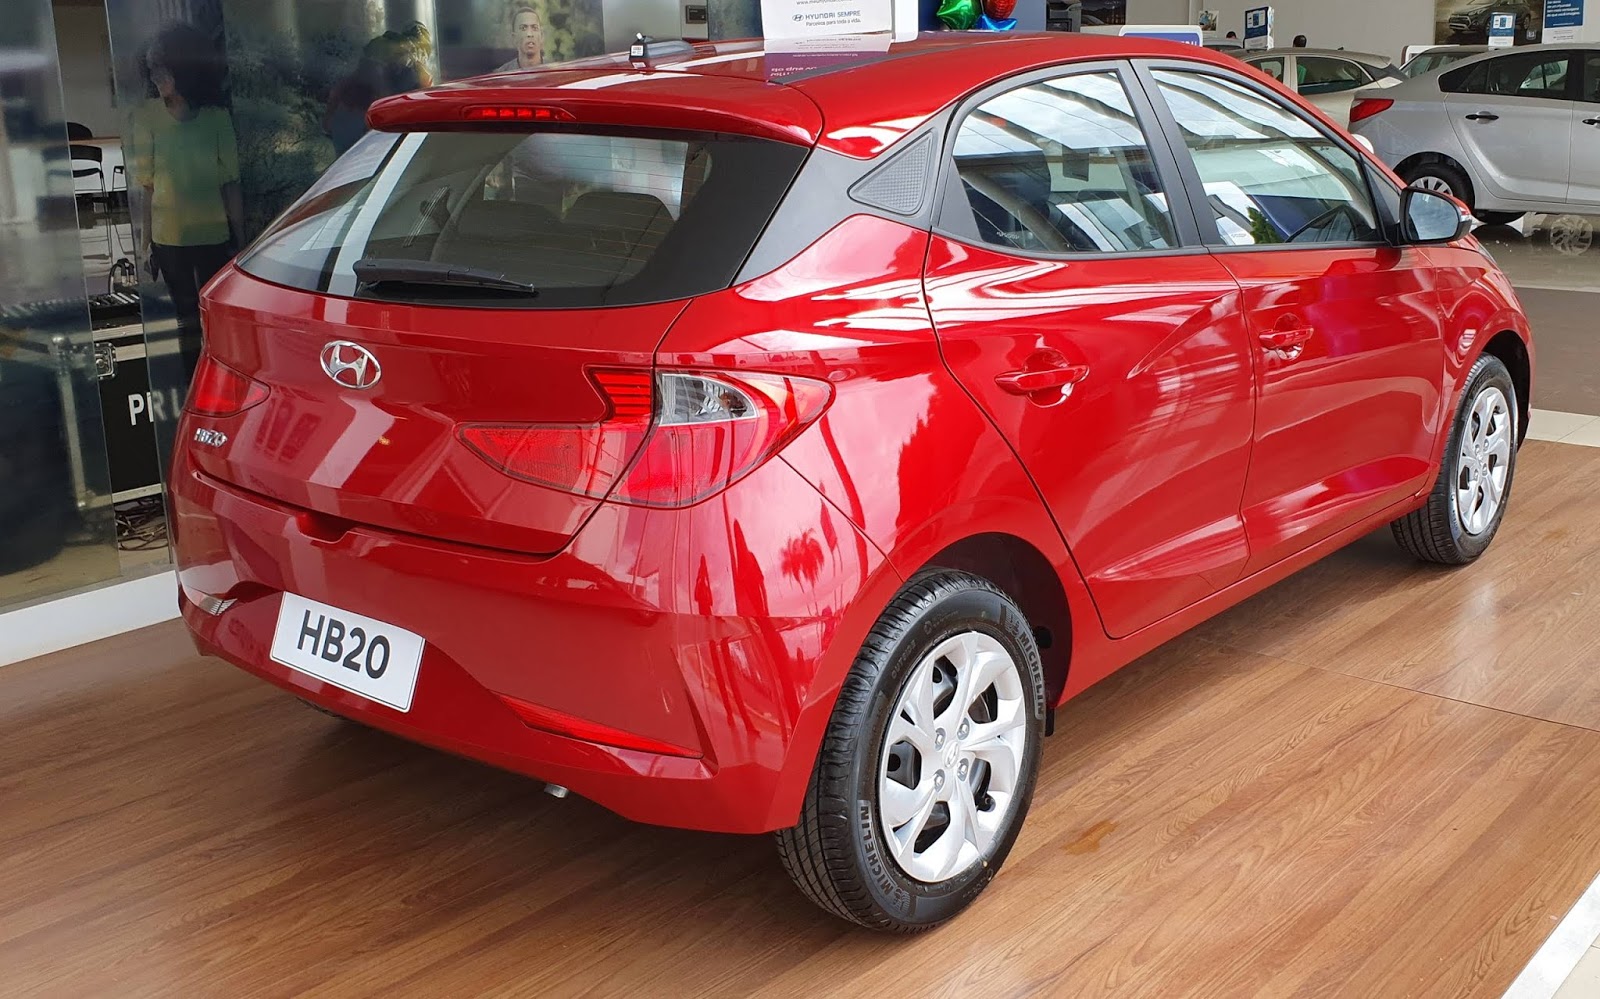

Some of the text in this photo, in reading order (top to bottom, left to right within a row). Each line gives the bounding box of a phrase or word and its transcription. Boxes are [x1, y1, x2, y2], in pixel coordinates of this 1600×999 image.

[837, 10, 861, 18] SEMPRE
[297, 609, 391, 680] HB20
[1018, 630, 1045, 717] MICHELIN
[860, 805, 895, 896] MICHELIN
